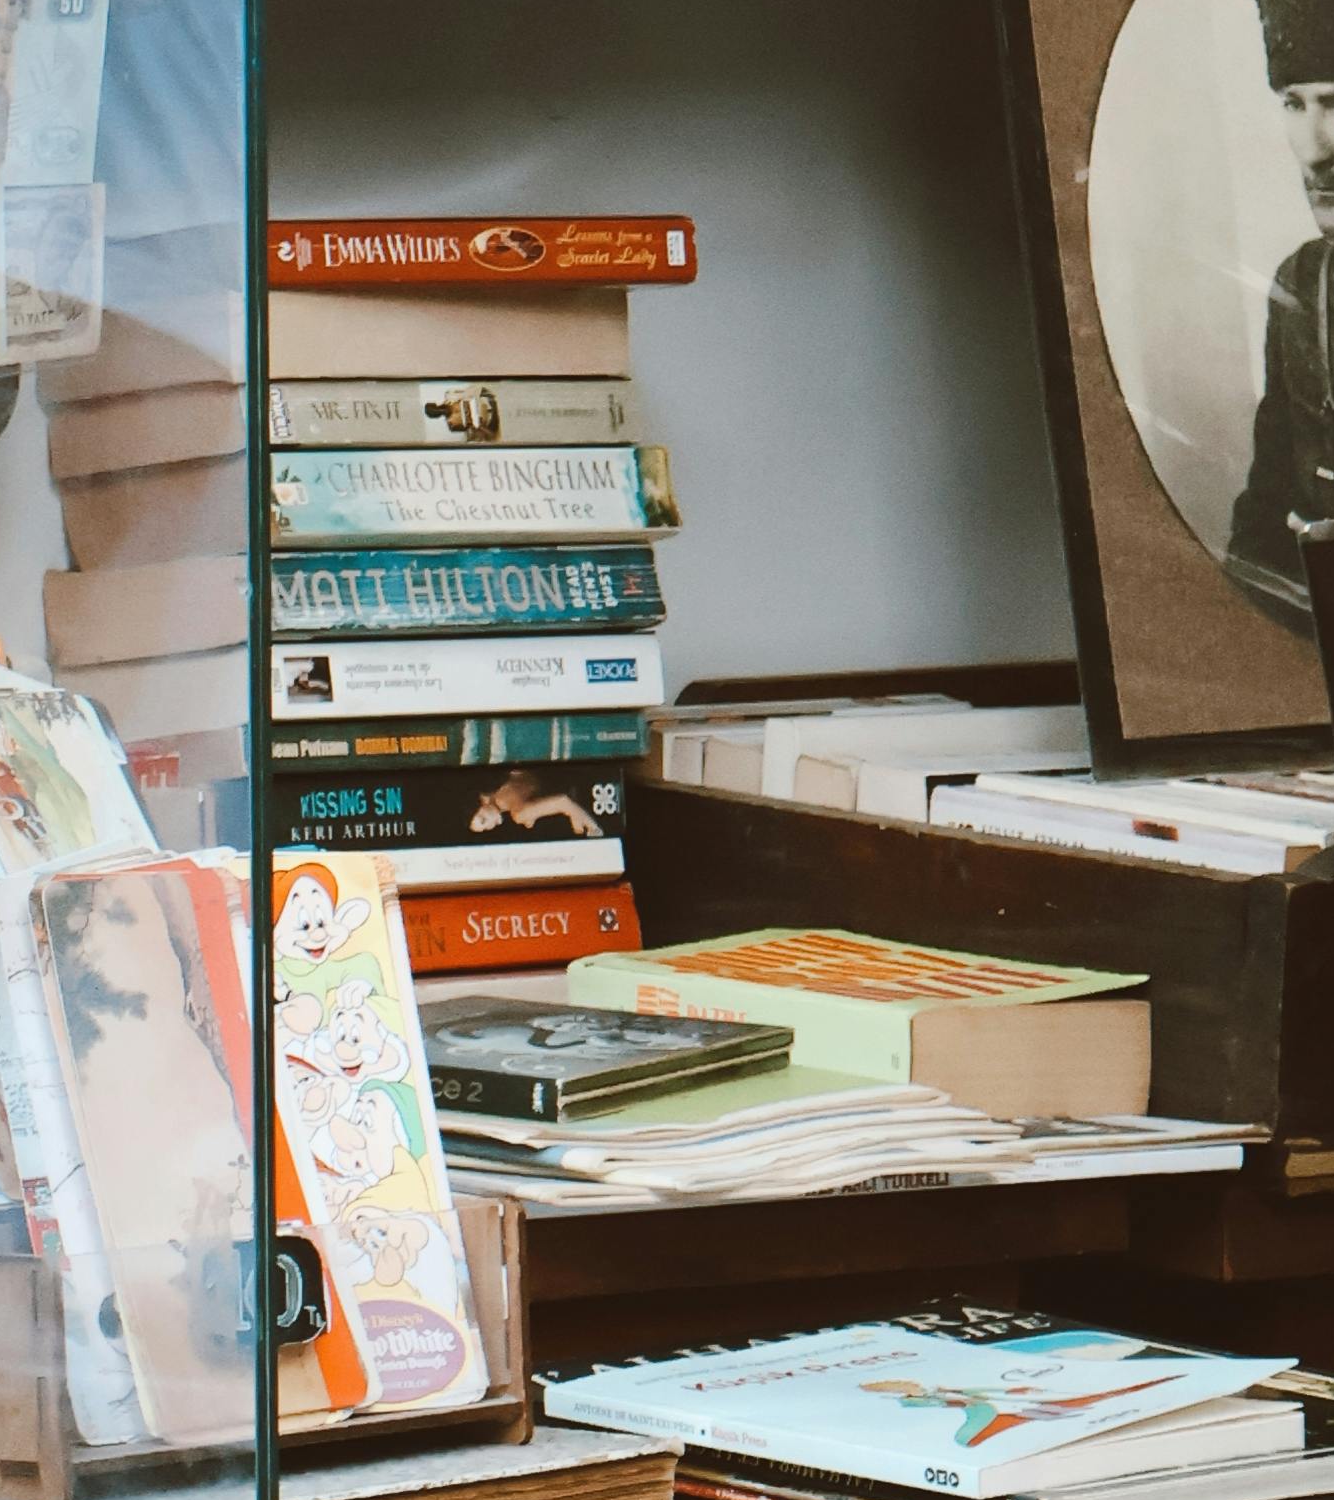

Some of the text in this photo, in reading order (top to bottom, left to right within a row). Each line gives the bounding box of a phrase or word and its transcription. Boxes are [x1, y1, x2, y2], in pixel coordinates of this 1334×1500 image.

[323, 231, 462, 268] EMMA WILDES
[328, 459, 616, 496] CHARLOTTE BINGHAM
[382, 497, 596, 522] The Chestnut Tree
[272, 563, 567, 617] MATT HILTON
[495, 657, 565, 677] KENNEDY
[300, 786, 403, 819] KISSING SIN
[291, 821, 417, 843] KERI ARTHUR
[461, 910, 572, 945] SECRECY
[466, 1082, 485, 1103] 2
[385, 1328, 457, 1357] White
